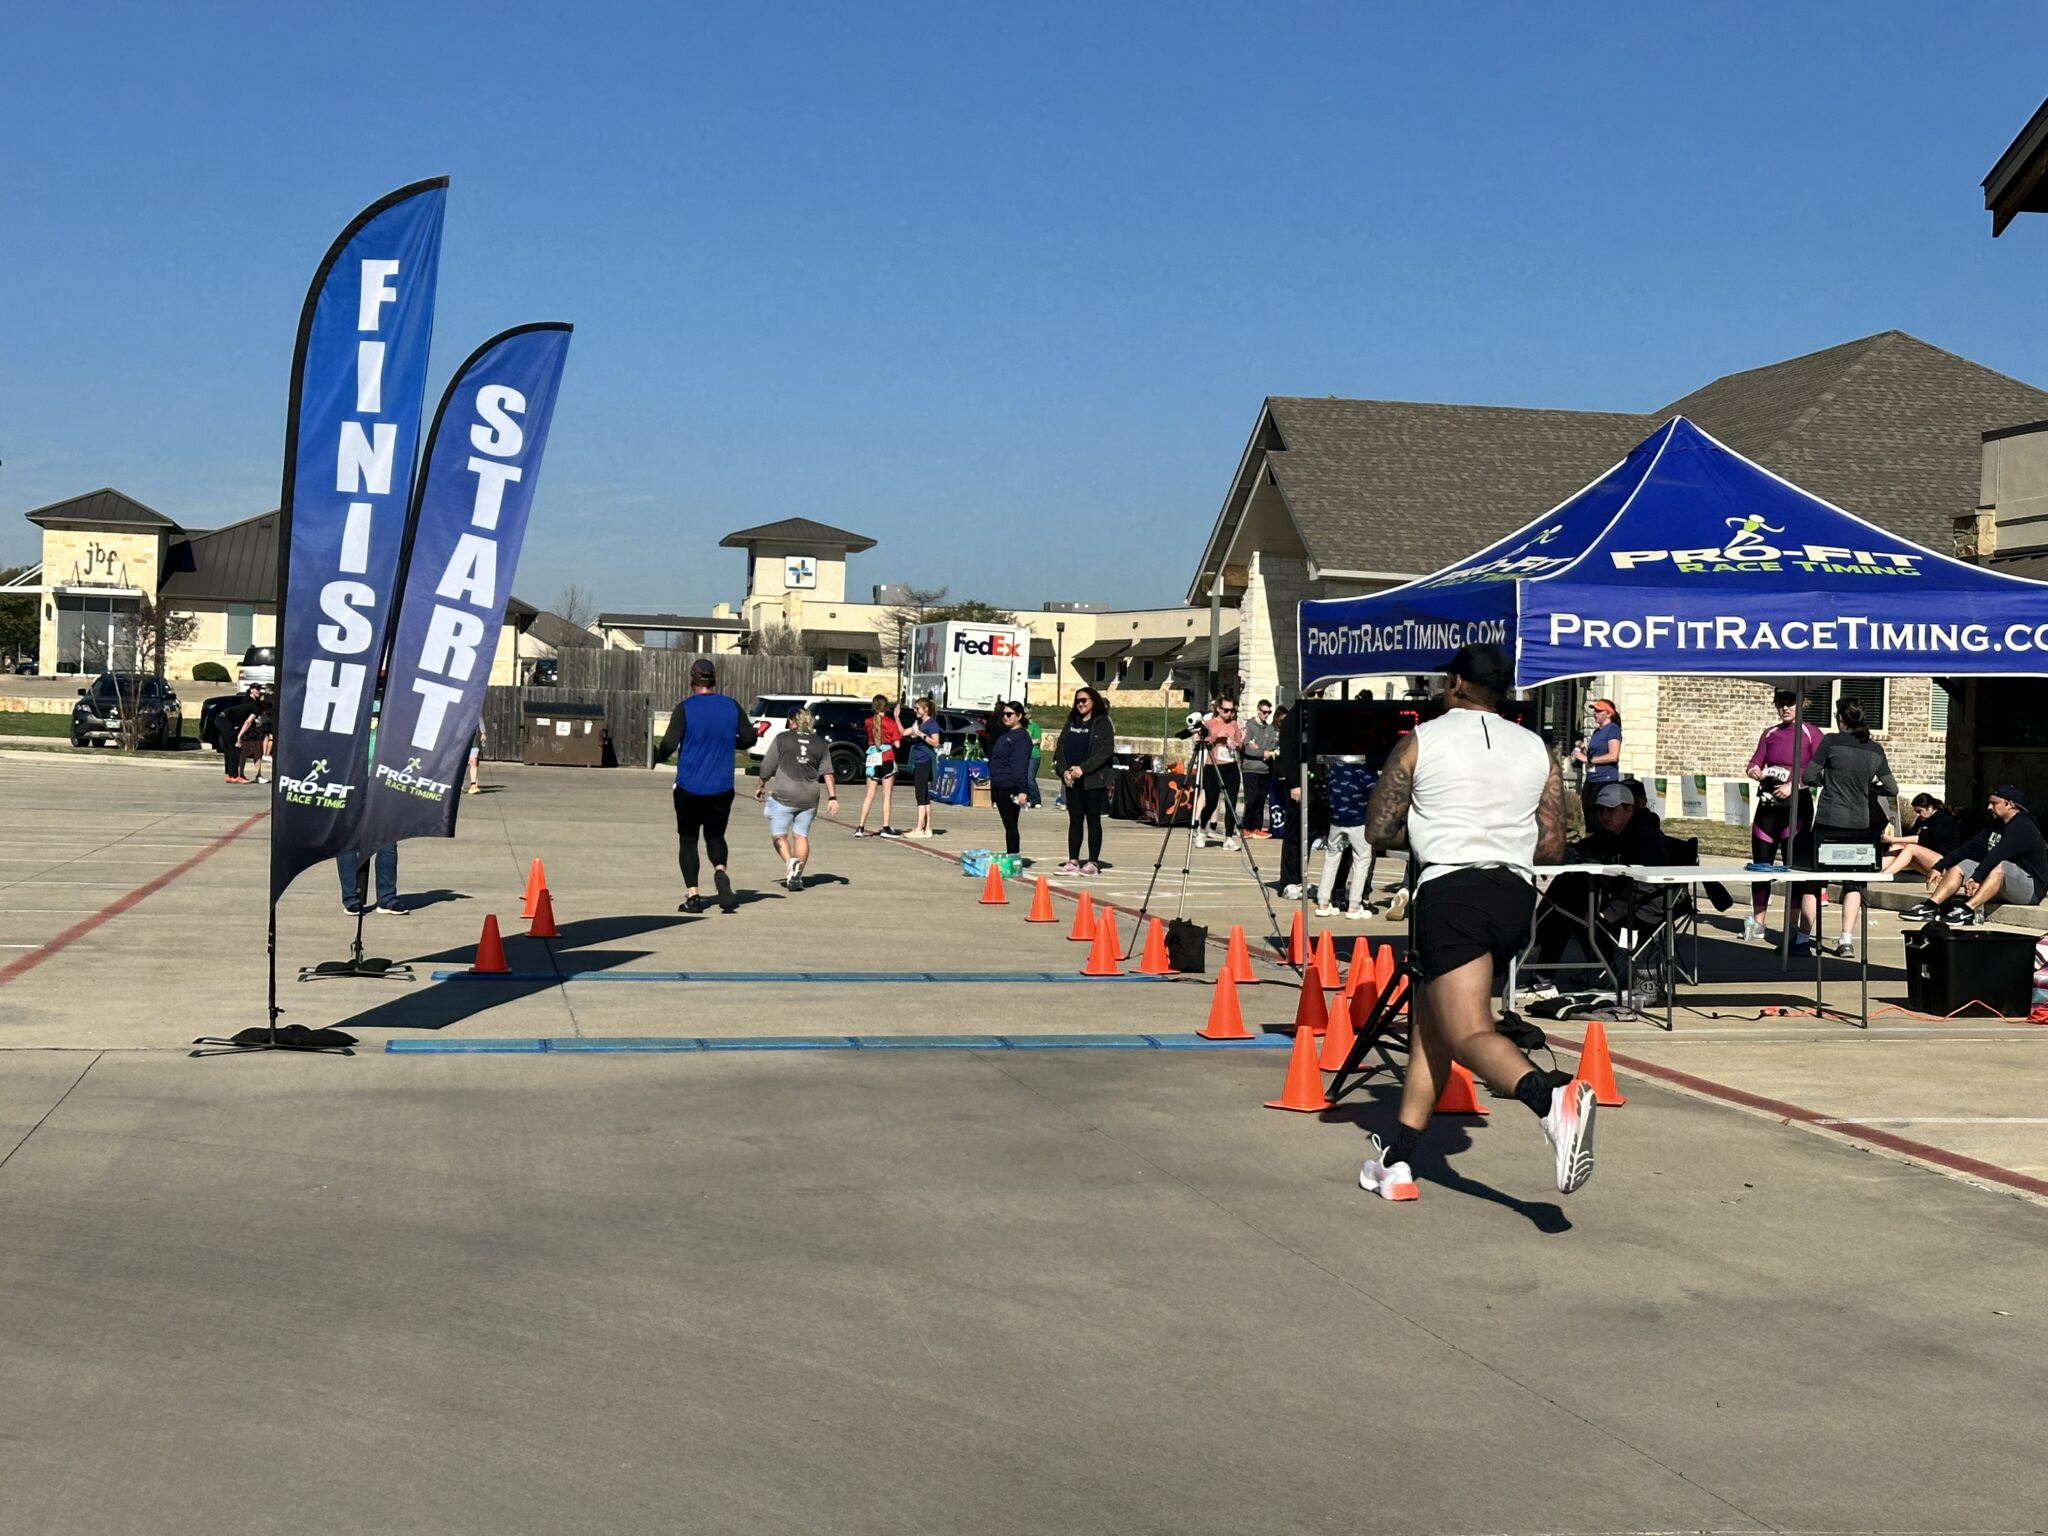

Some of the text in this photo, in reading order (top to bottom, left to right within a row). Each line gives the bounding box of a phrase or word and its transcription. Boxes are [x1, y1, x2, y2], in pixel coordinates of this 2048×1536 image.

[300, 258, 399, 735] FINISH
[84, 541, 118, 576] jbf
[410, 384, 526, 751] START
[1609, 544, 1922, 570] PRO-FIT
[1676, 560, 1922, 577] RACE TIMING
[953, 631, 1021, 657] FedEx
[375, 763, 452, 794] PRO-FIT
[384, 778, 443, 802] RACE TIMING
[286, 791, 312, 805] RACE
